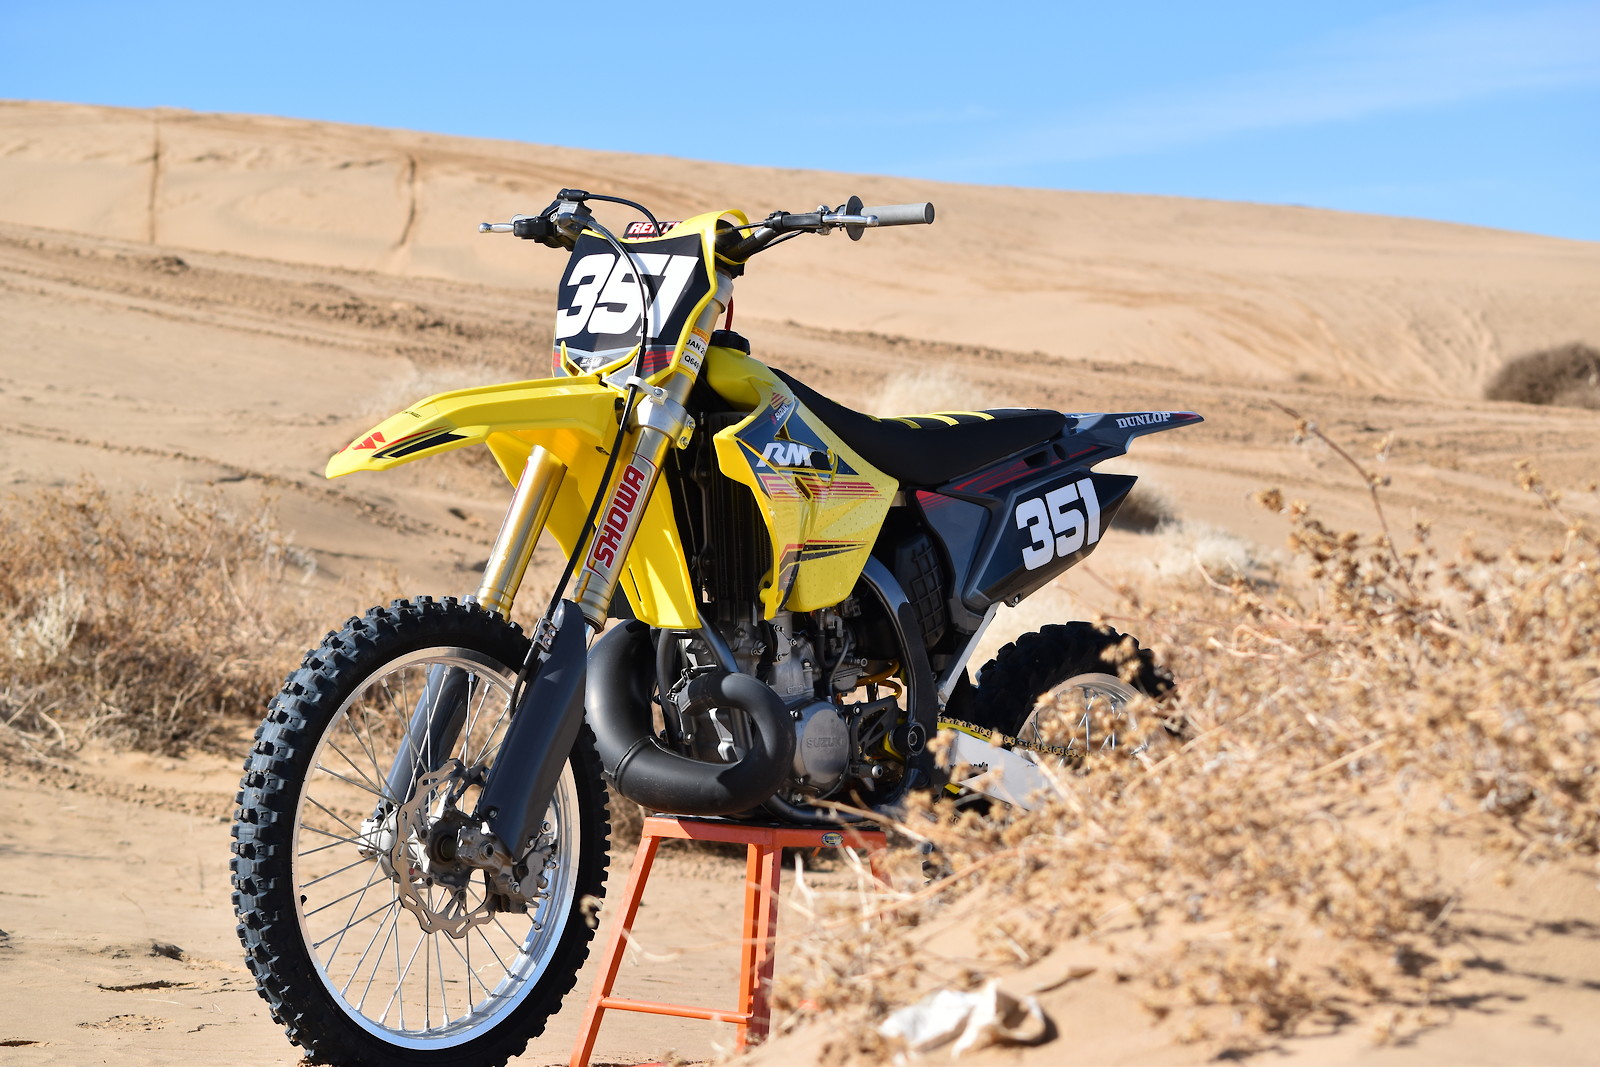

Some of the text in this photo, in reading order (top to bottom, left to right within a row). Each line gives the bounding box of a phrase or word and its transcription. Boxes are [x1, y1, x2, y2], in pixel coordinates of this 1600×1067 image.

[556, 253, 699, 340] 351
[686, 339, 702, 351] JAN
[1115, 412, 1171, 428] DUNLOP
[756, 442, 812, 467] RM
[594, 464, 645, 568] SHOWA
[1015, 477, 1101, 571] 351
